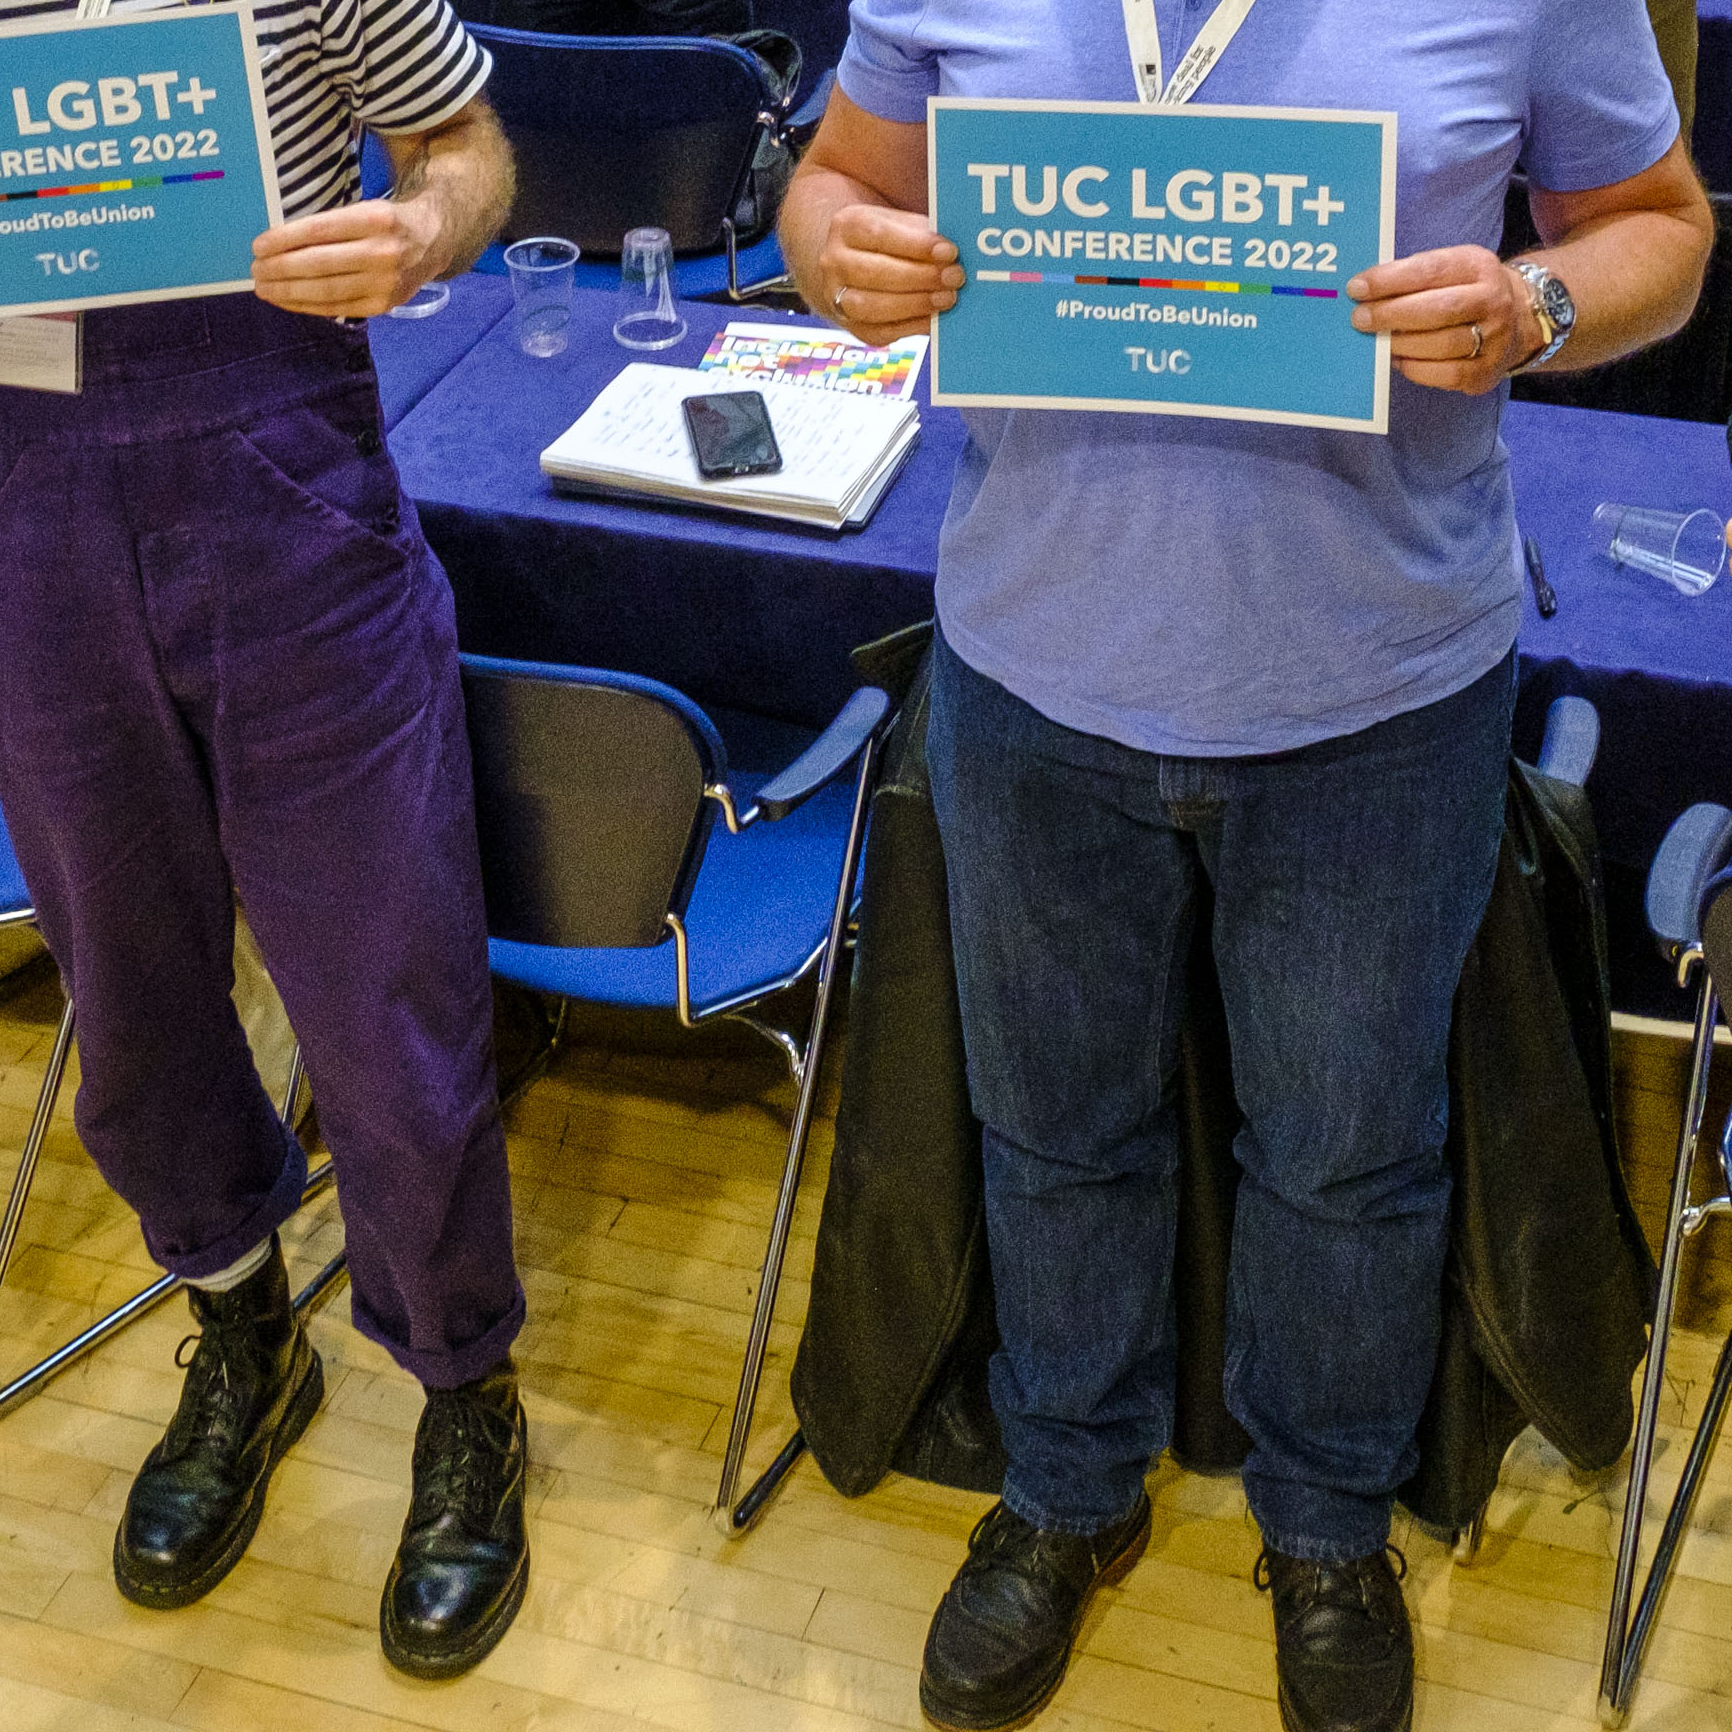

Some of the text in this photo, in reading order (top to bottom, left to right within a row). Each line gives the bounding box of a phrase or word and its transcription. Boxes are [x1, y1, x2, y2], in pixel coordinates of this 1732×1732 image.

[11, 70, 217, 134] LGBT+
[129, 129, 219, 164] 2022
[966, 162, 1345, 226] TUC LGBT+
[34, 248, 99, 276] TUC
[976, 227, 1338, 272] CONFERENCE 2022
[1055, 299, 1257, 328] #ProudToBeUnion
[1123, 345, 1190, 375] TUC
